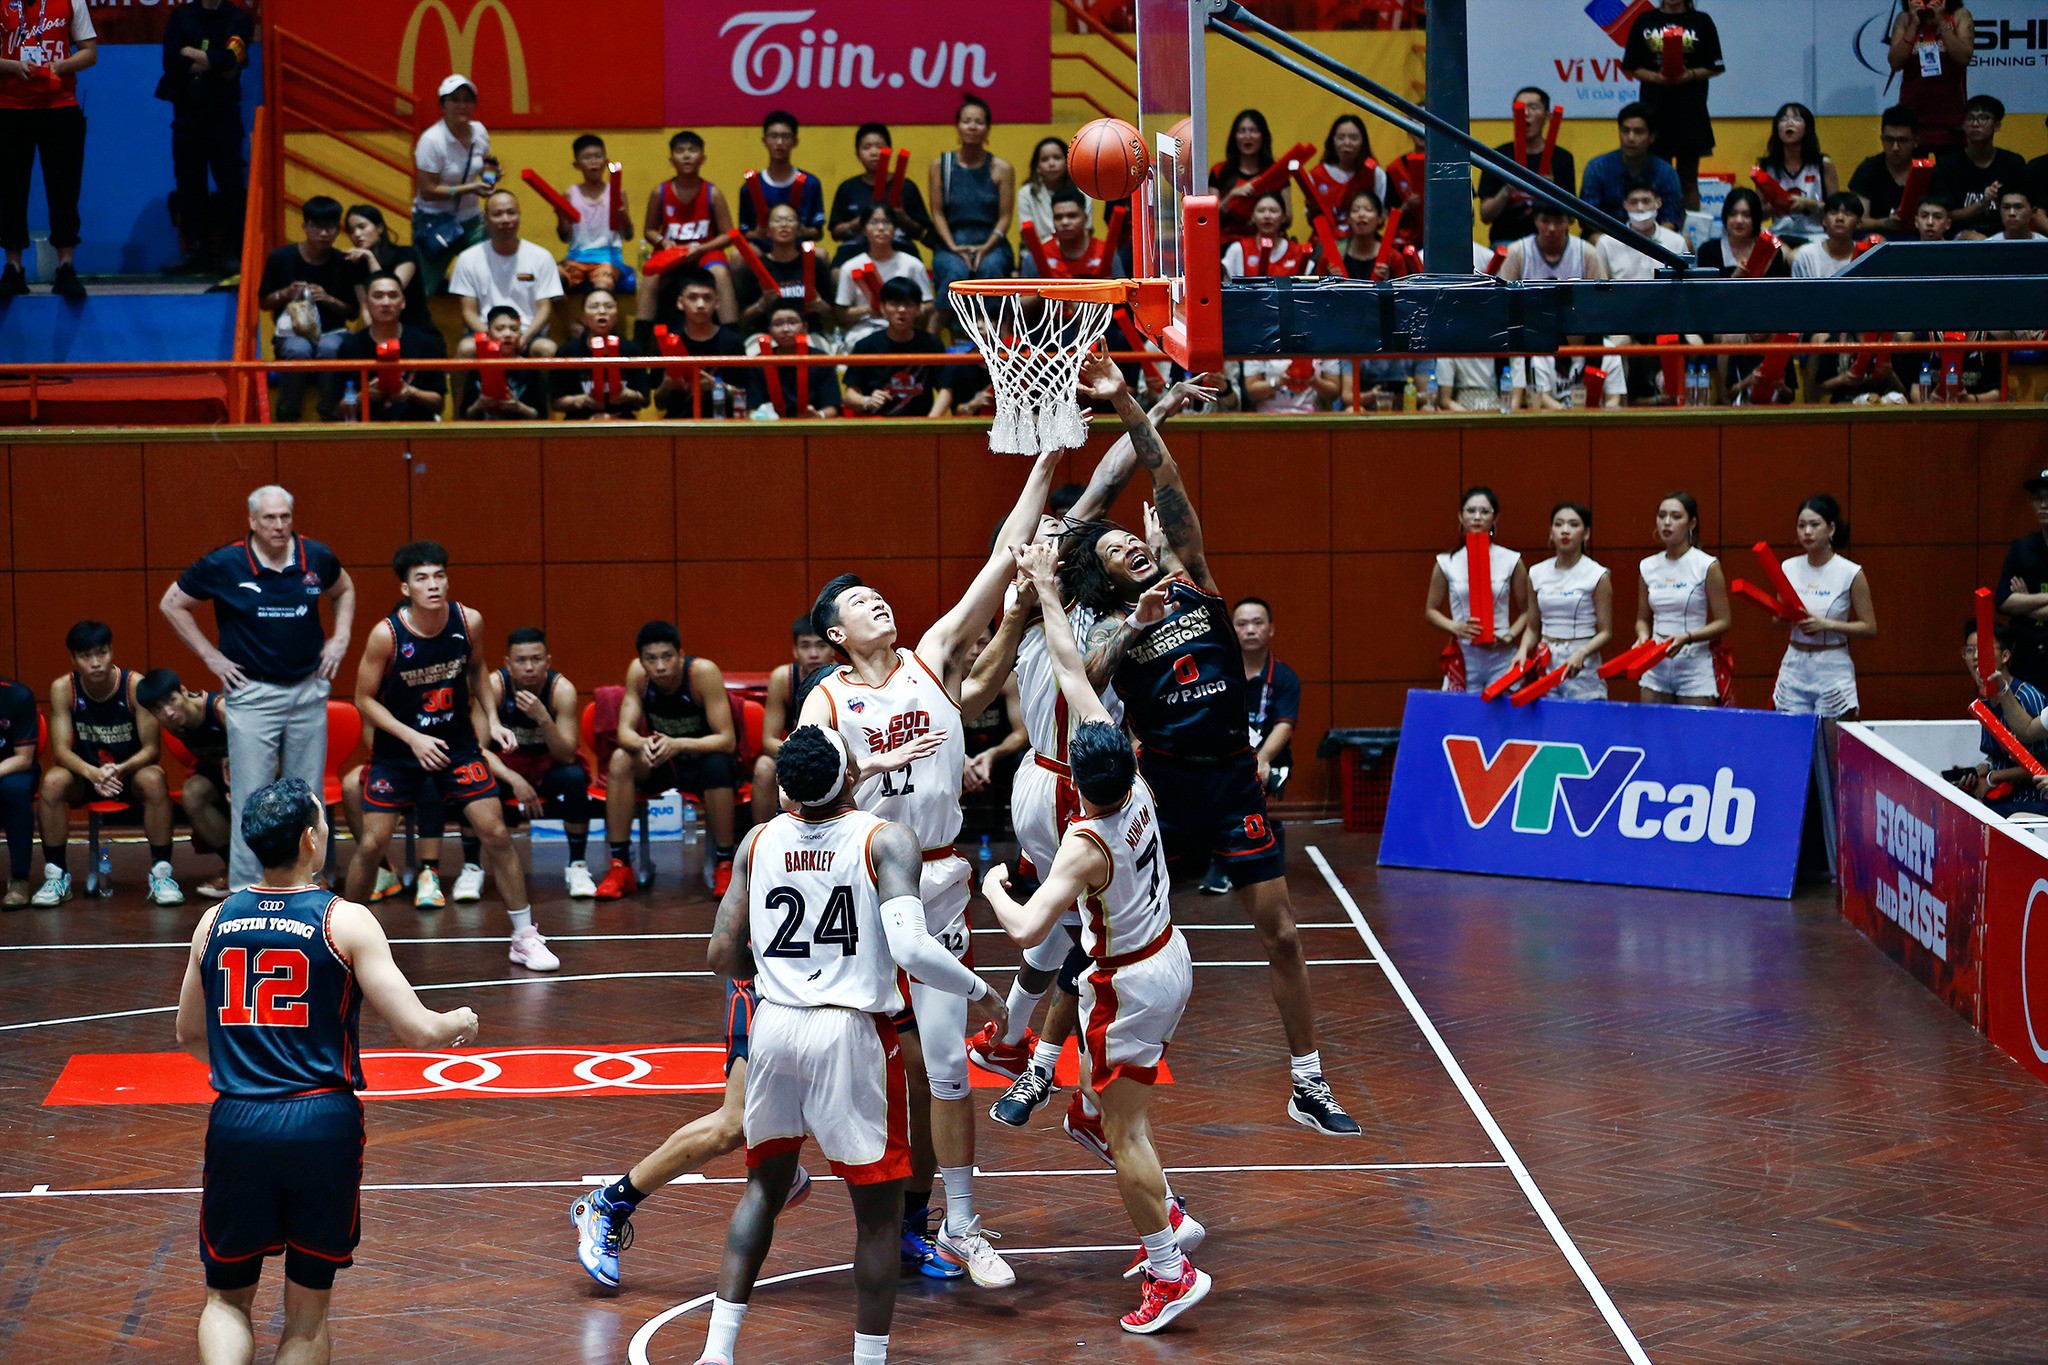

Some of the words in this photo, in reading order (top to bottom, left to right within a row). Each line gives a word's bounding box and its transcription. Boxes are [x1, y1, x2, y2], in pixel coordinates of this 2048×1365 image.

[718, 9, 998, 96] Tiin.vn
[1967, 55, 2036, 67] SHINING
[1136, 619, 1212, 665] WARRIORS
[422, 687, 455, 712] 30
[1181, 680, 1227, 702] PJICO
[453, 761, 489, 785] 30
[1442, 734, 1756, 846] VTVcab
[1875, 789, 1936, 884] FIGHT
[784, 850, 836, 873] BARKLEY
[1135, 830, 1161, 907] 7
[216, 917, 268, 938] JUSTIN
[269, 917, 316, 940] YOUNG
[762, 885, 859, 959] 24
[1875, 877, 1899, 922] AND
[1898, 870, 1948, 962] RISE
[942, 932, 964, 951] 12
[217, 946, 310, 1028] 12
